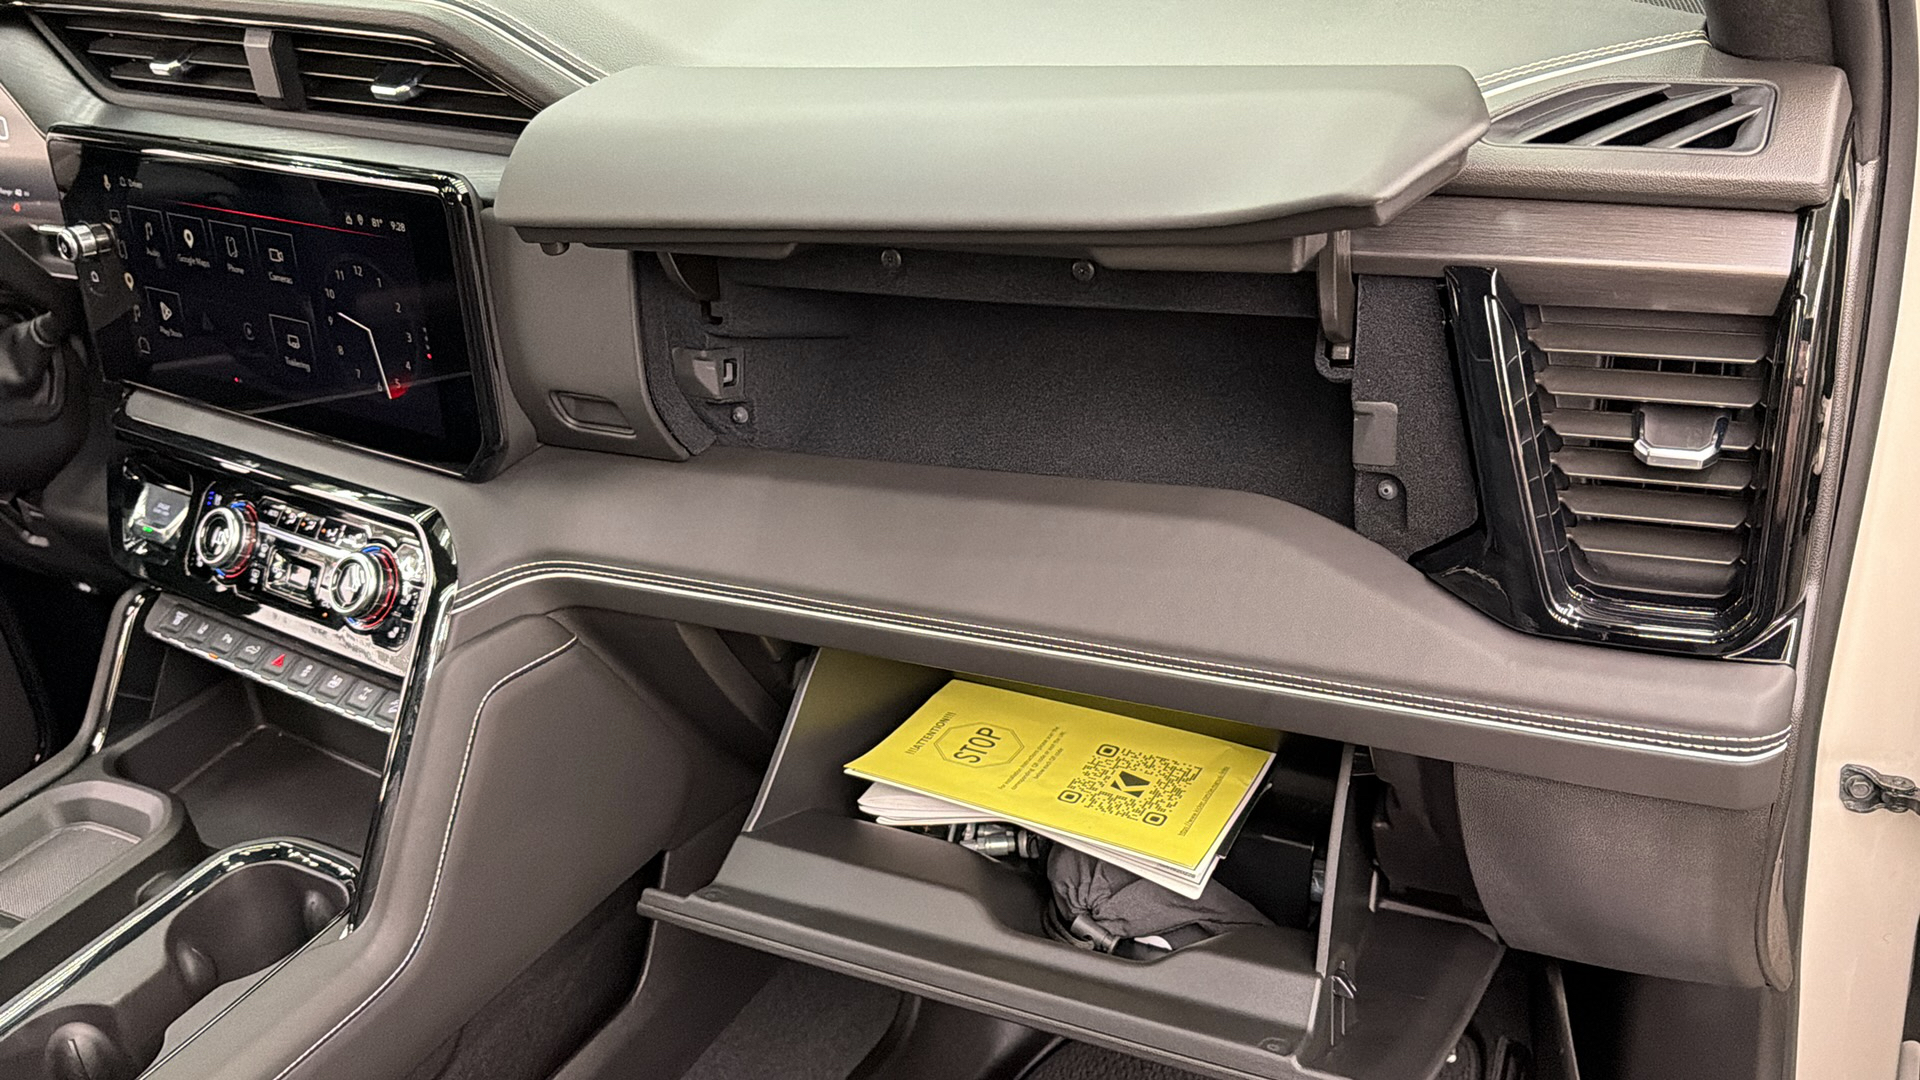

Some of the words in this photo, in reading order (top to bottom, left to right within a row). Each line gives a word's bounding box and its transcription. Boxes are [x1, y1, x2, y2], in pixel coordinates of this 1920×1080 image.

[226, 262, 245, 276] Phone
[335, 269, 345, 281] 11
[353, 265, 363, 277] 12
[268, 271, 294, 285] Cameras
[376, 277, 382, 288] 1
[324, 287, 335, 299] 10
[395, 302, 402, 313] 2
[327, 315, 333, 326] 9
[405, 331, 412, 343] 3
[336, 344, 344, 356] 8
[405, 361, 411, 371] 4
[355, 368, 361, 379] 7
[394, 378, 401, 388] 5
[953, 727, 1001, 763] STOP
